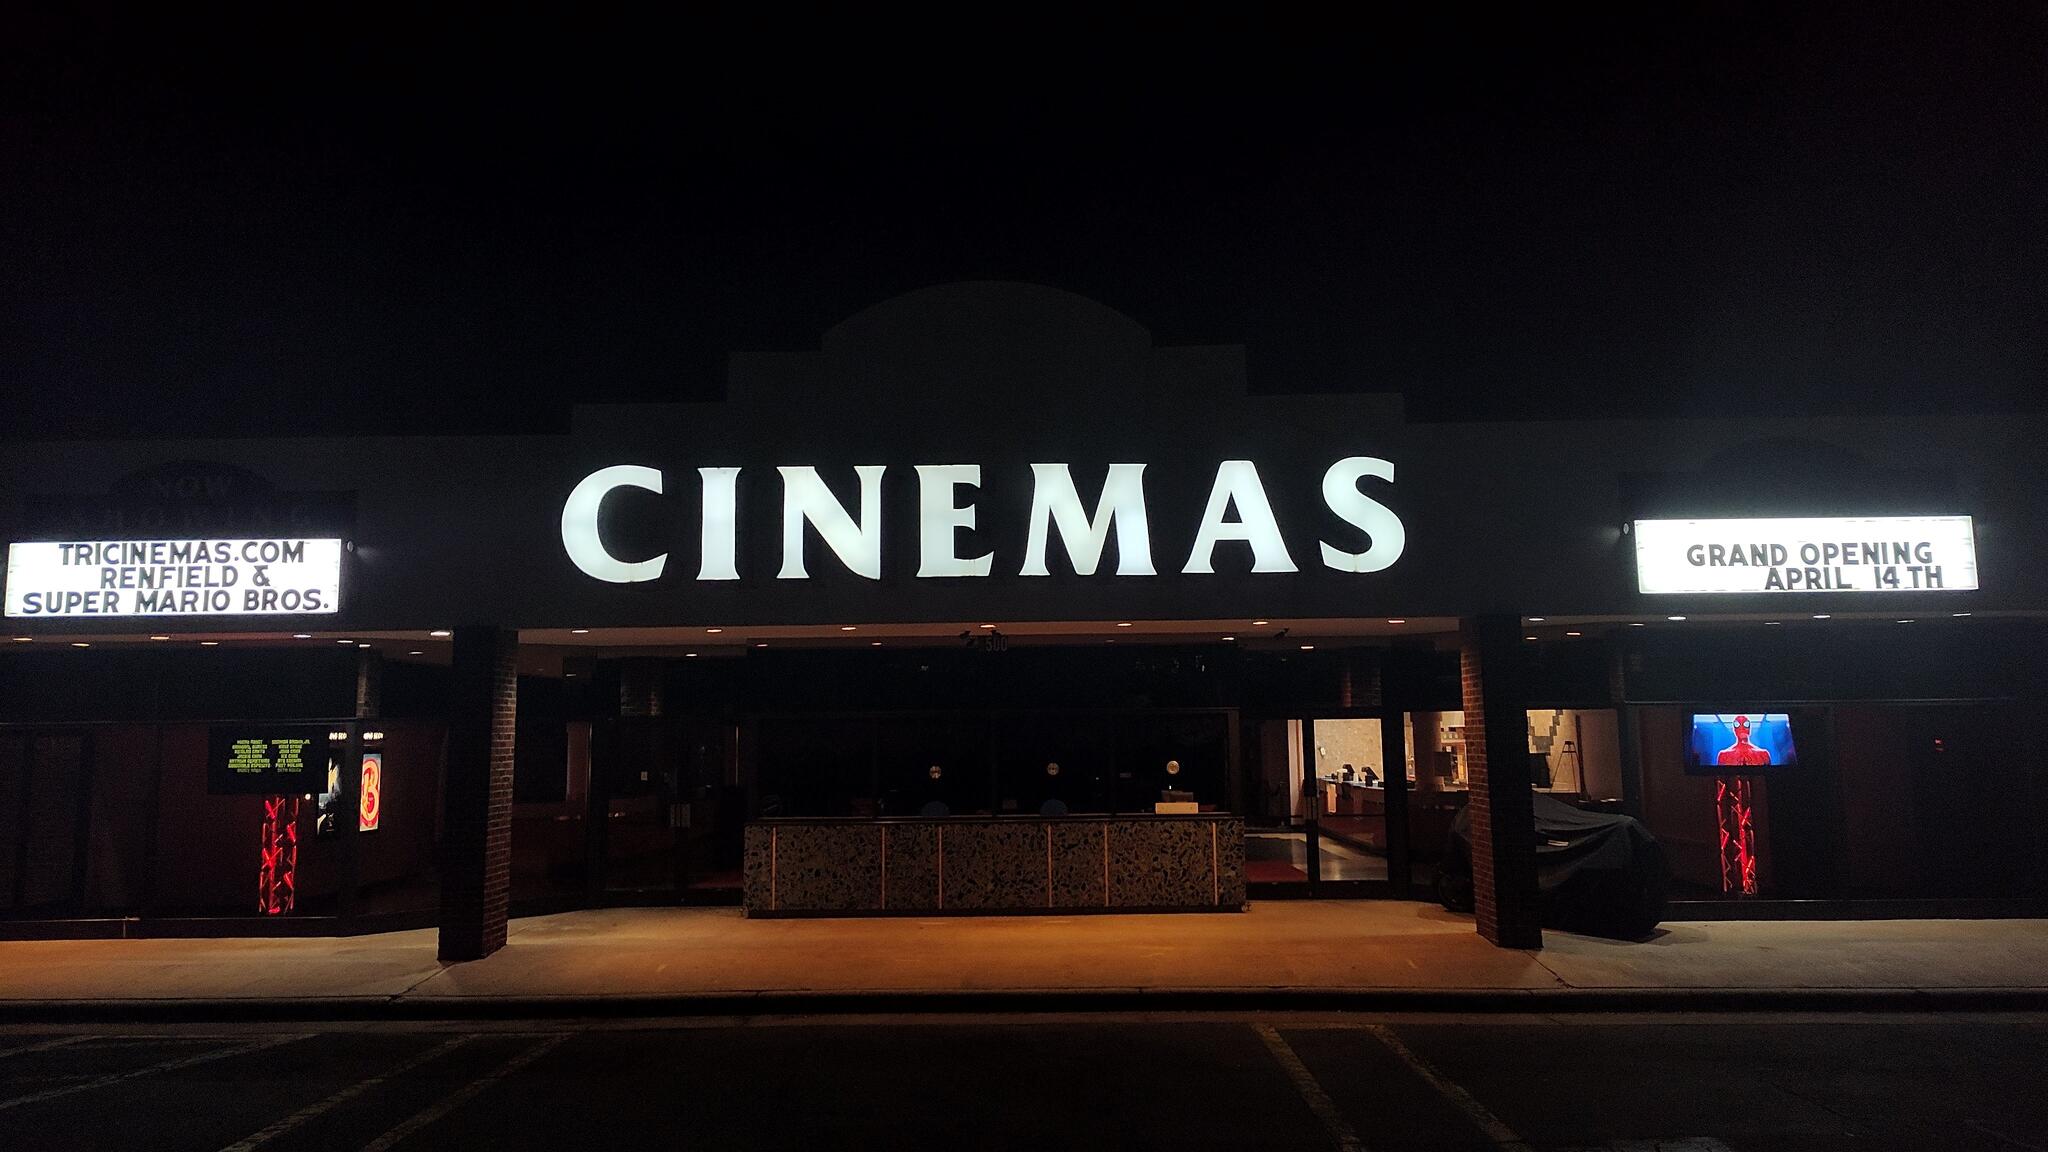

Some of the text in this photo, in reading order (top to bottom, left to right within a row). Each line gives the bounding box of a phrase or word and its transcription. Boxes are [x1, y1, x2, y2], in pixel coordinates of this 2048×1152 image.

[561, 456, 1406, 583] CINEMAS
[58, 541, 305, 566] TRICINEMAS.COM
[1686, 541, 1933, 568] GRAND OPENING
[100, 564, 270, 590] RENFIELD &
[1764, 566, 1853, 591] APRIL
[22, 588, 329, 614] SUPER MARIO BROS.
